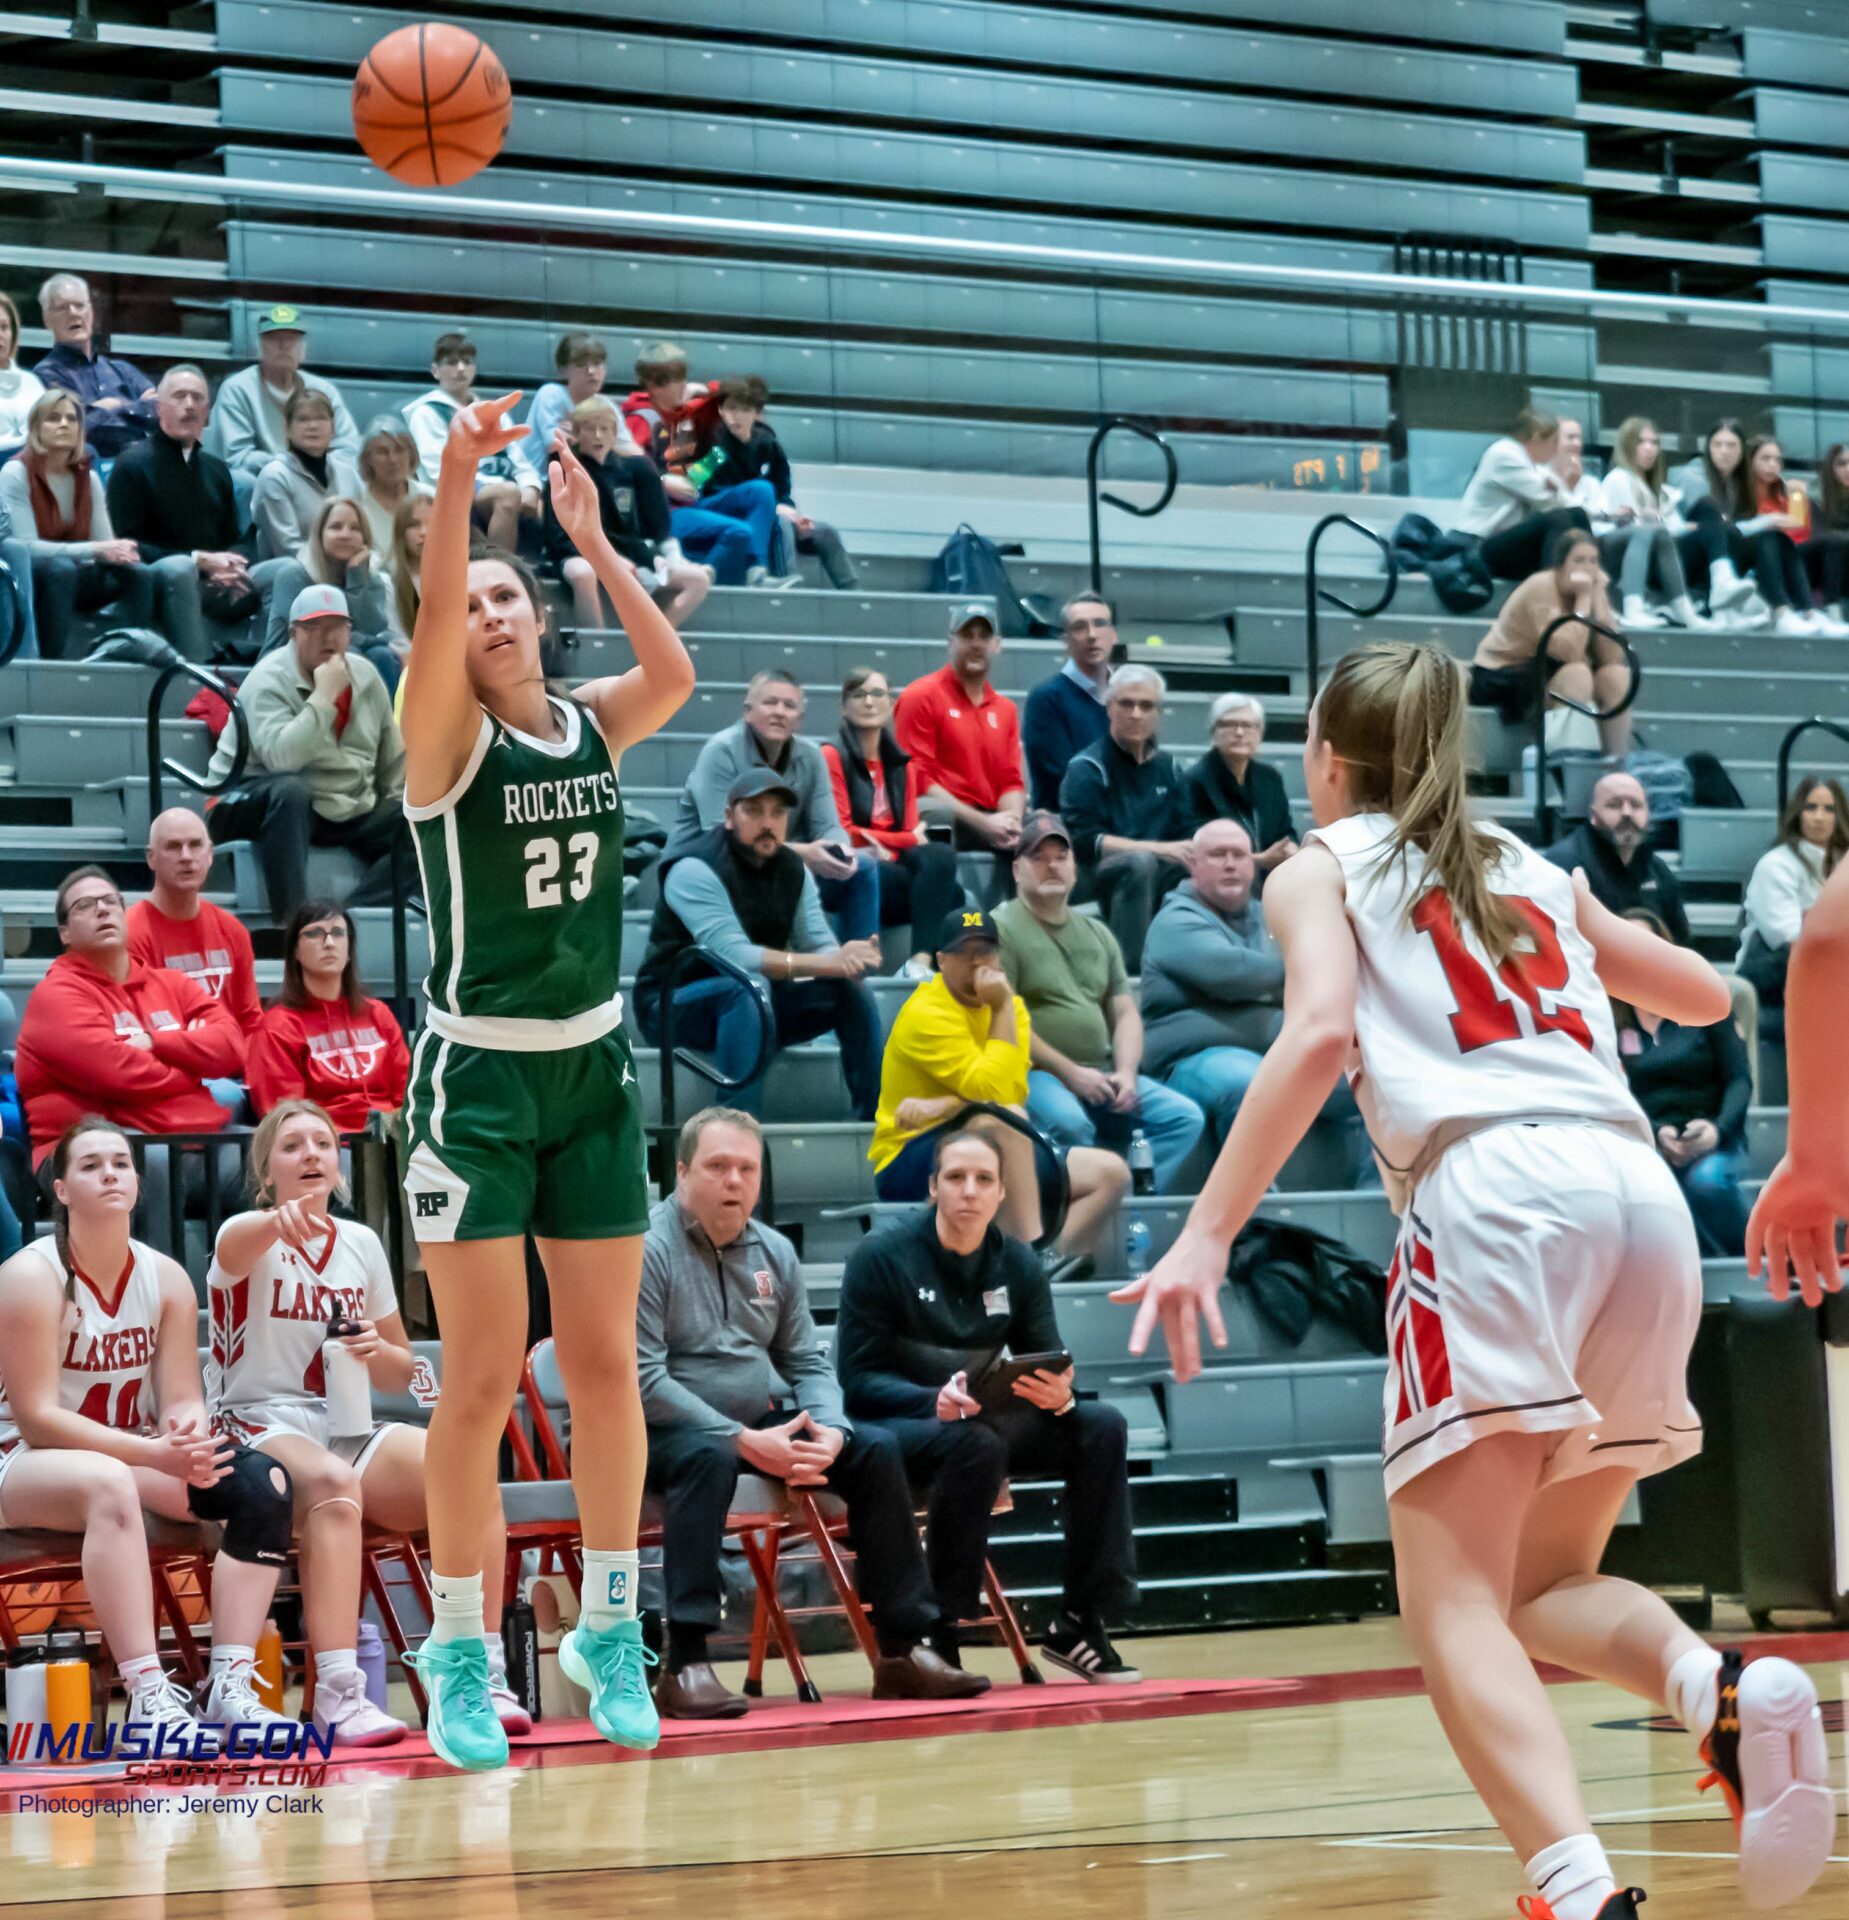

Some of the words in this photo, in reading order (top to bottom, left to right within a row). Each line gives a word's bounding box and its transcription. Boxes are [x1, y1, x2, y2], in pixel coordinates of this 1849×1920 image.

[503, 771, 617, 824] ROCKETS
[524, 831, 600, 909] 23
[962, 911, 983, 927] M
[1412, 885, 1594, 1054] 12
